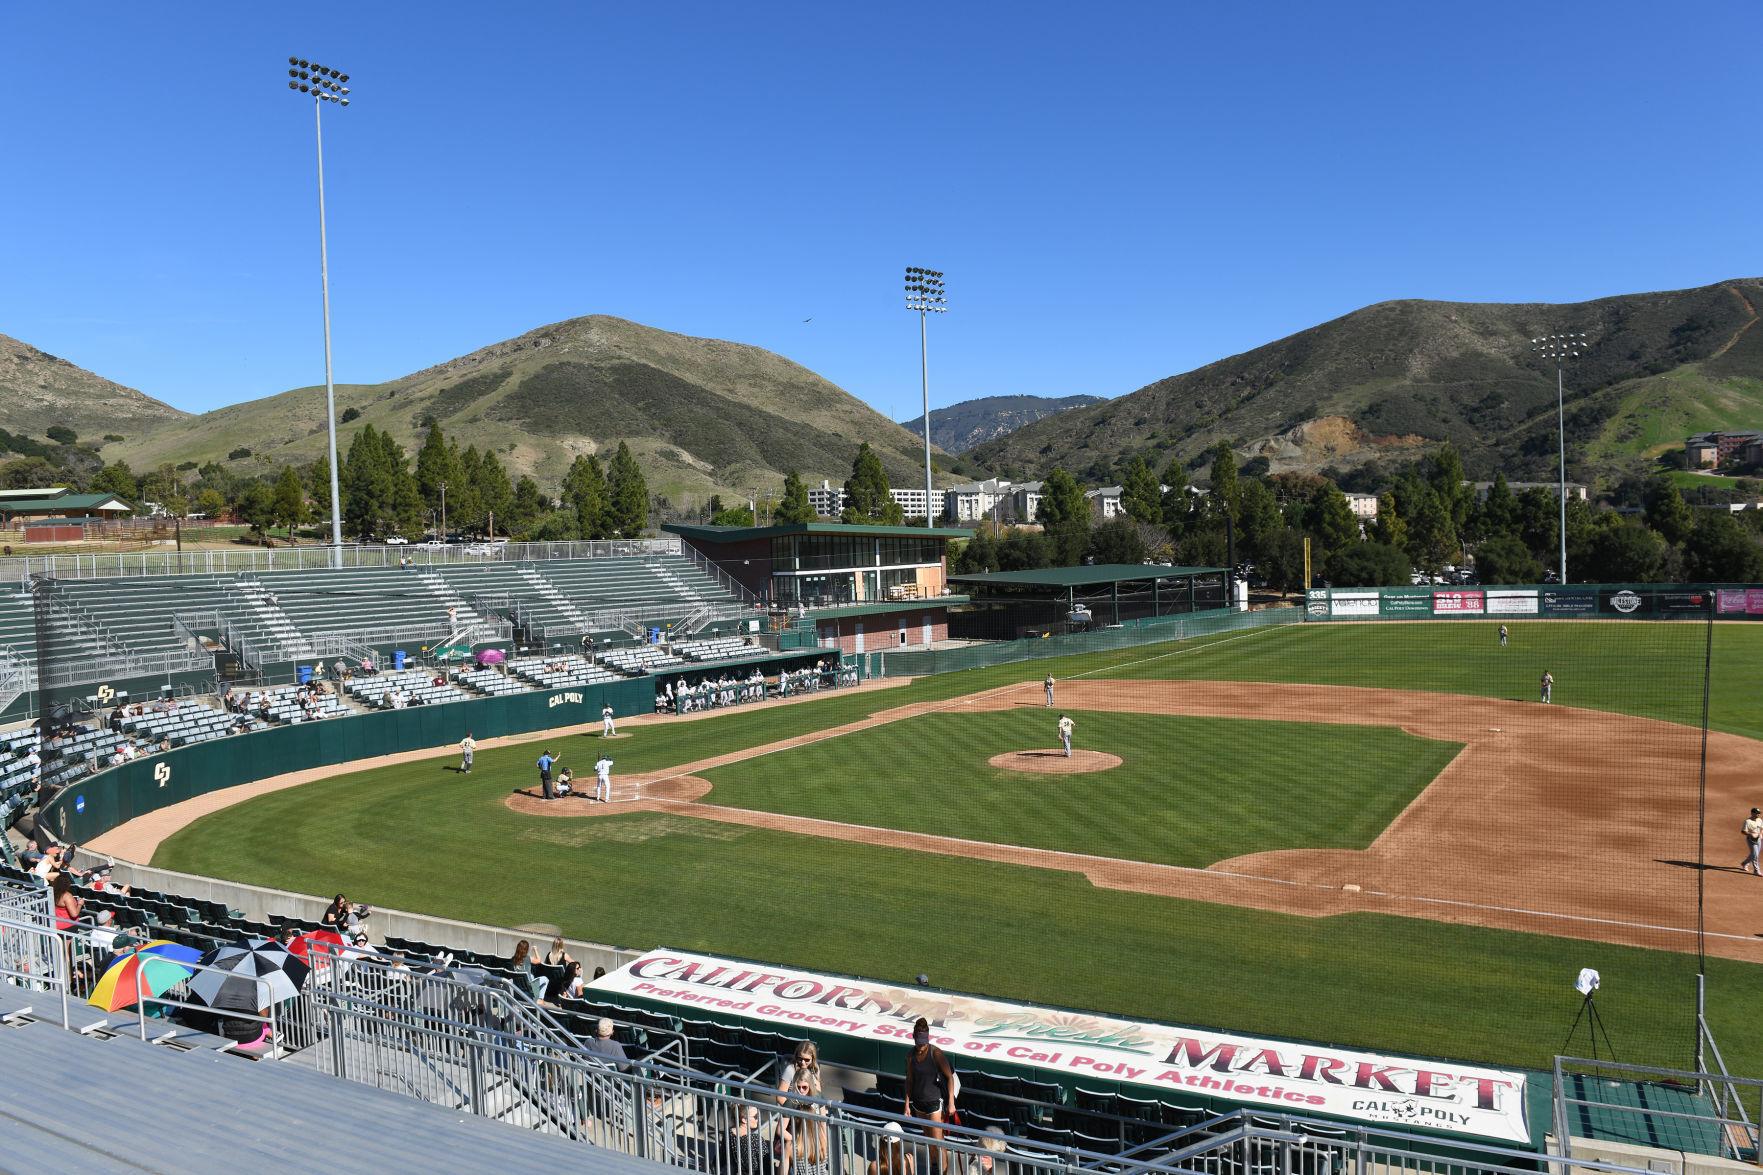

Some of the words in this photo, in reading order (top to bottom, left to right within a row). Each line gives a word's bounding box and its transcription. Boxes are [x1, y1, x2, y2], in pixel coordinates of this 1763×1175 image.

[1309, 590, 1327, 599] 335
[549, 693, 563, 708] CAL
[564, 692, 583, 704] POLY
[629, 957, 947, 1028] CALIFORNIA
[631, 982, 756, 1011] Preferred
[756, 1004, 868, 1033] Grocery
[963, 1041, 1002, 1054] of
[1006, 1046, 1062, 1065] Cal
[1069, 1055, 1146, 1080] Poly
[1155, 1070, 1327, 1106] Athletics
[1158, 1036, 1513, 1112] MARKET
[1352, 1100, 1390, 1111] CAL
[1420, 1107, 1471, 1126] POLY
[1369, 1113, 1454, 1129] MUSTANGS
